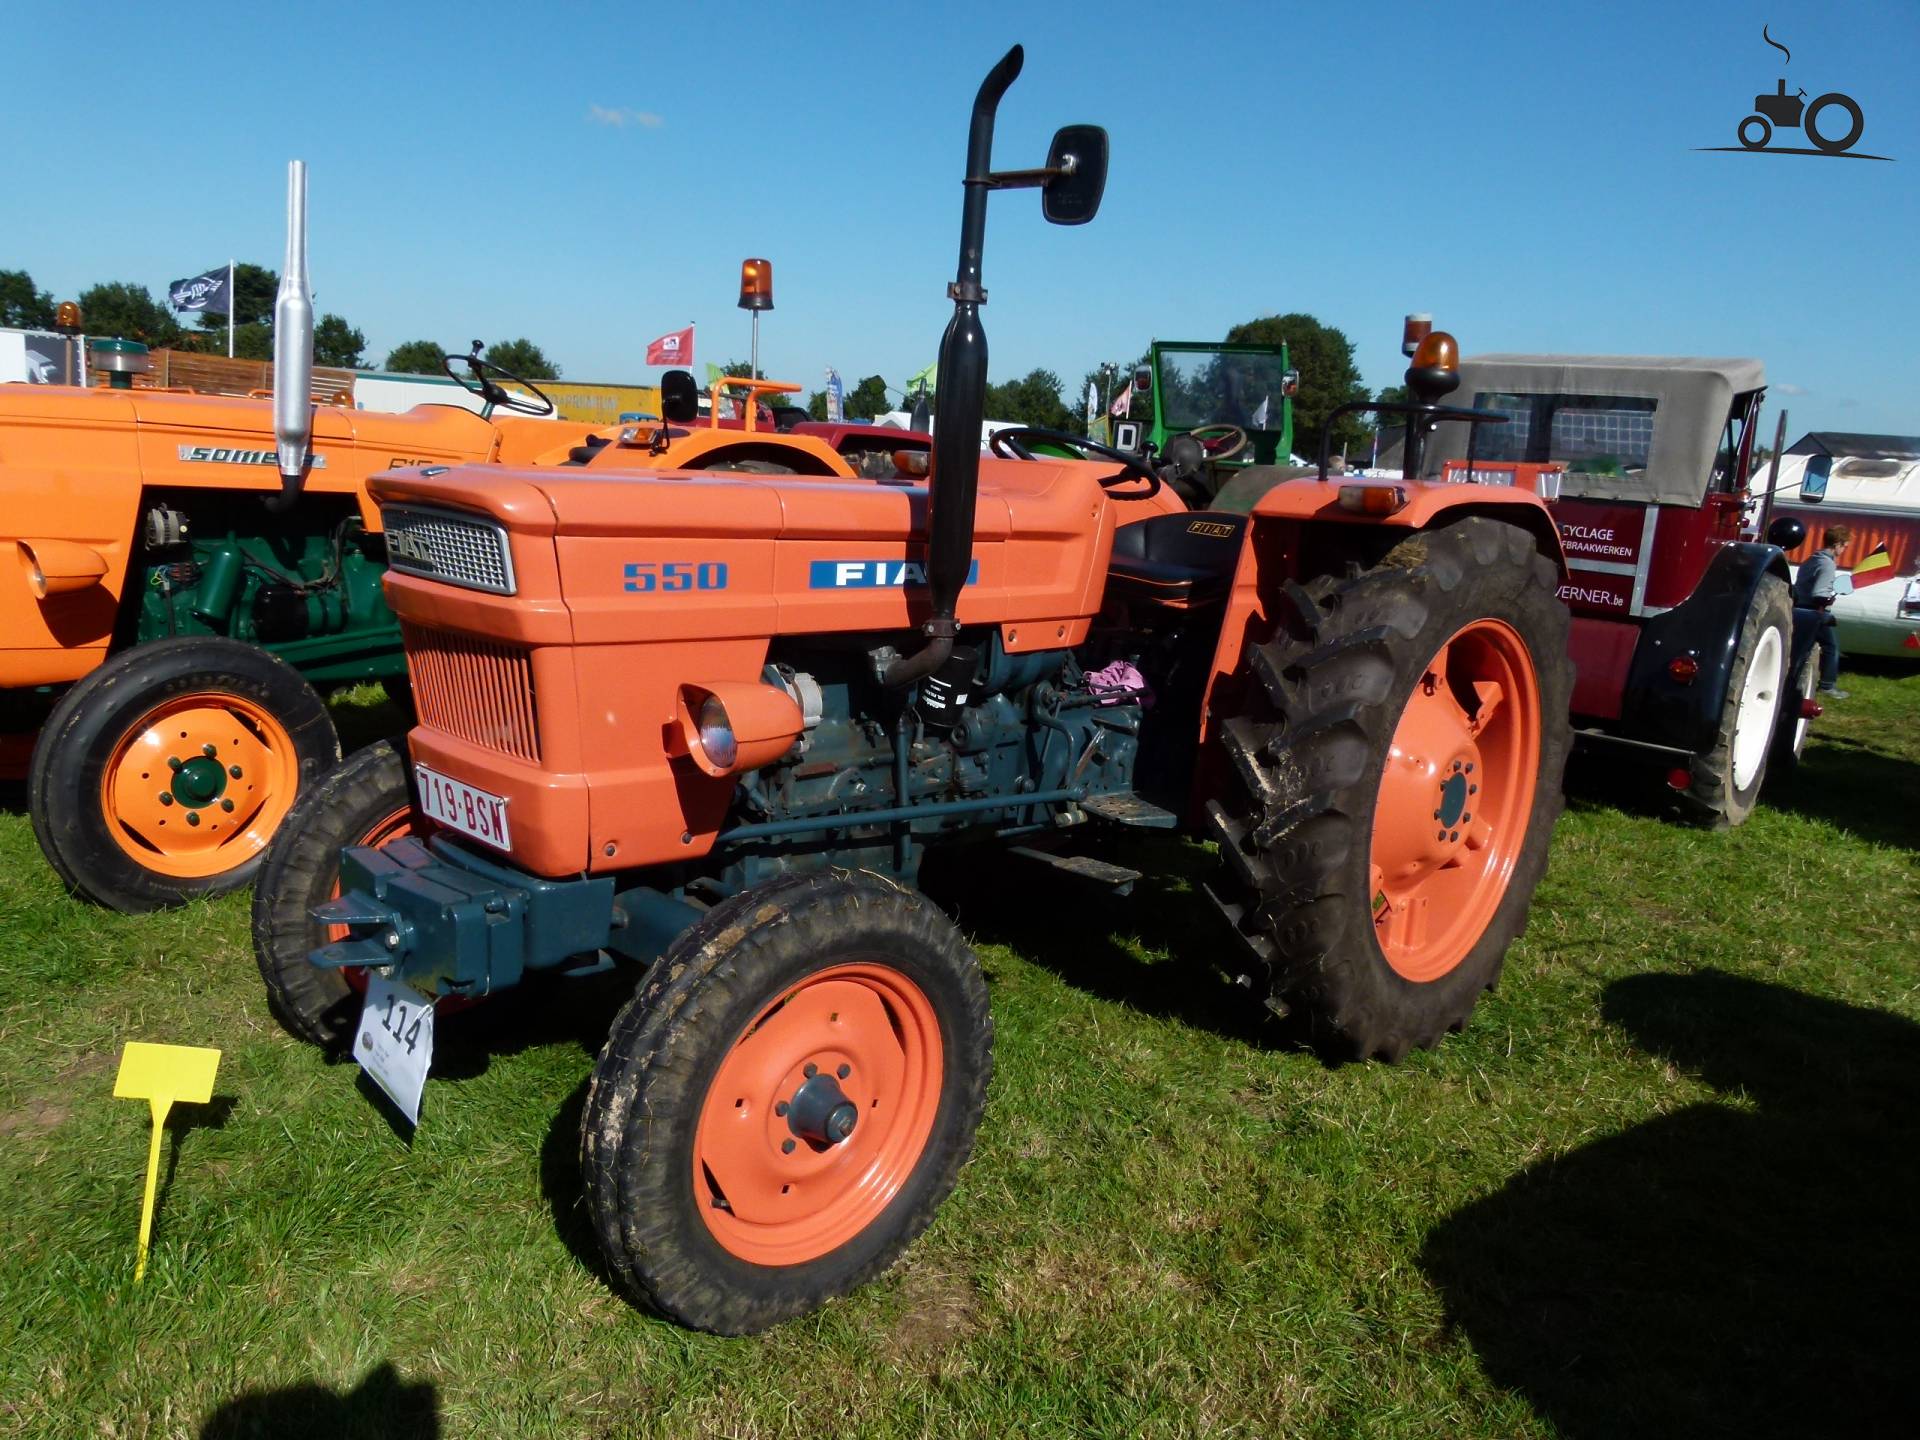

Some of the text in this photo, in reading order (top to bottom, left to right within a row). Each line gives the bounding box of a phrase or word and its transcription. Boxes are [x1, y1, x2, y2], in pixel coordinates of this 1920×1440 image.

[1192, 523, 1232, 535] FIAT
[384, 528, 433, 562] FIAT
[1561, 540, 1633, 557] FBRAAKWERKEN
[624, 562, 727, 592] 550
[836, 562, 928, 586] FIA
[372, 994, 421, 1056] 114
